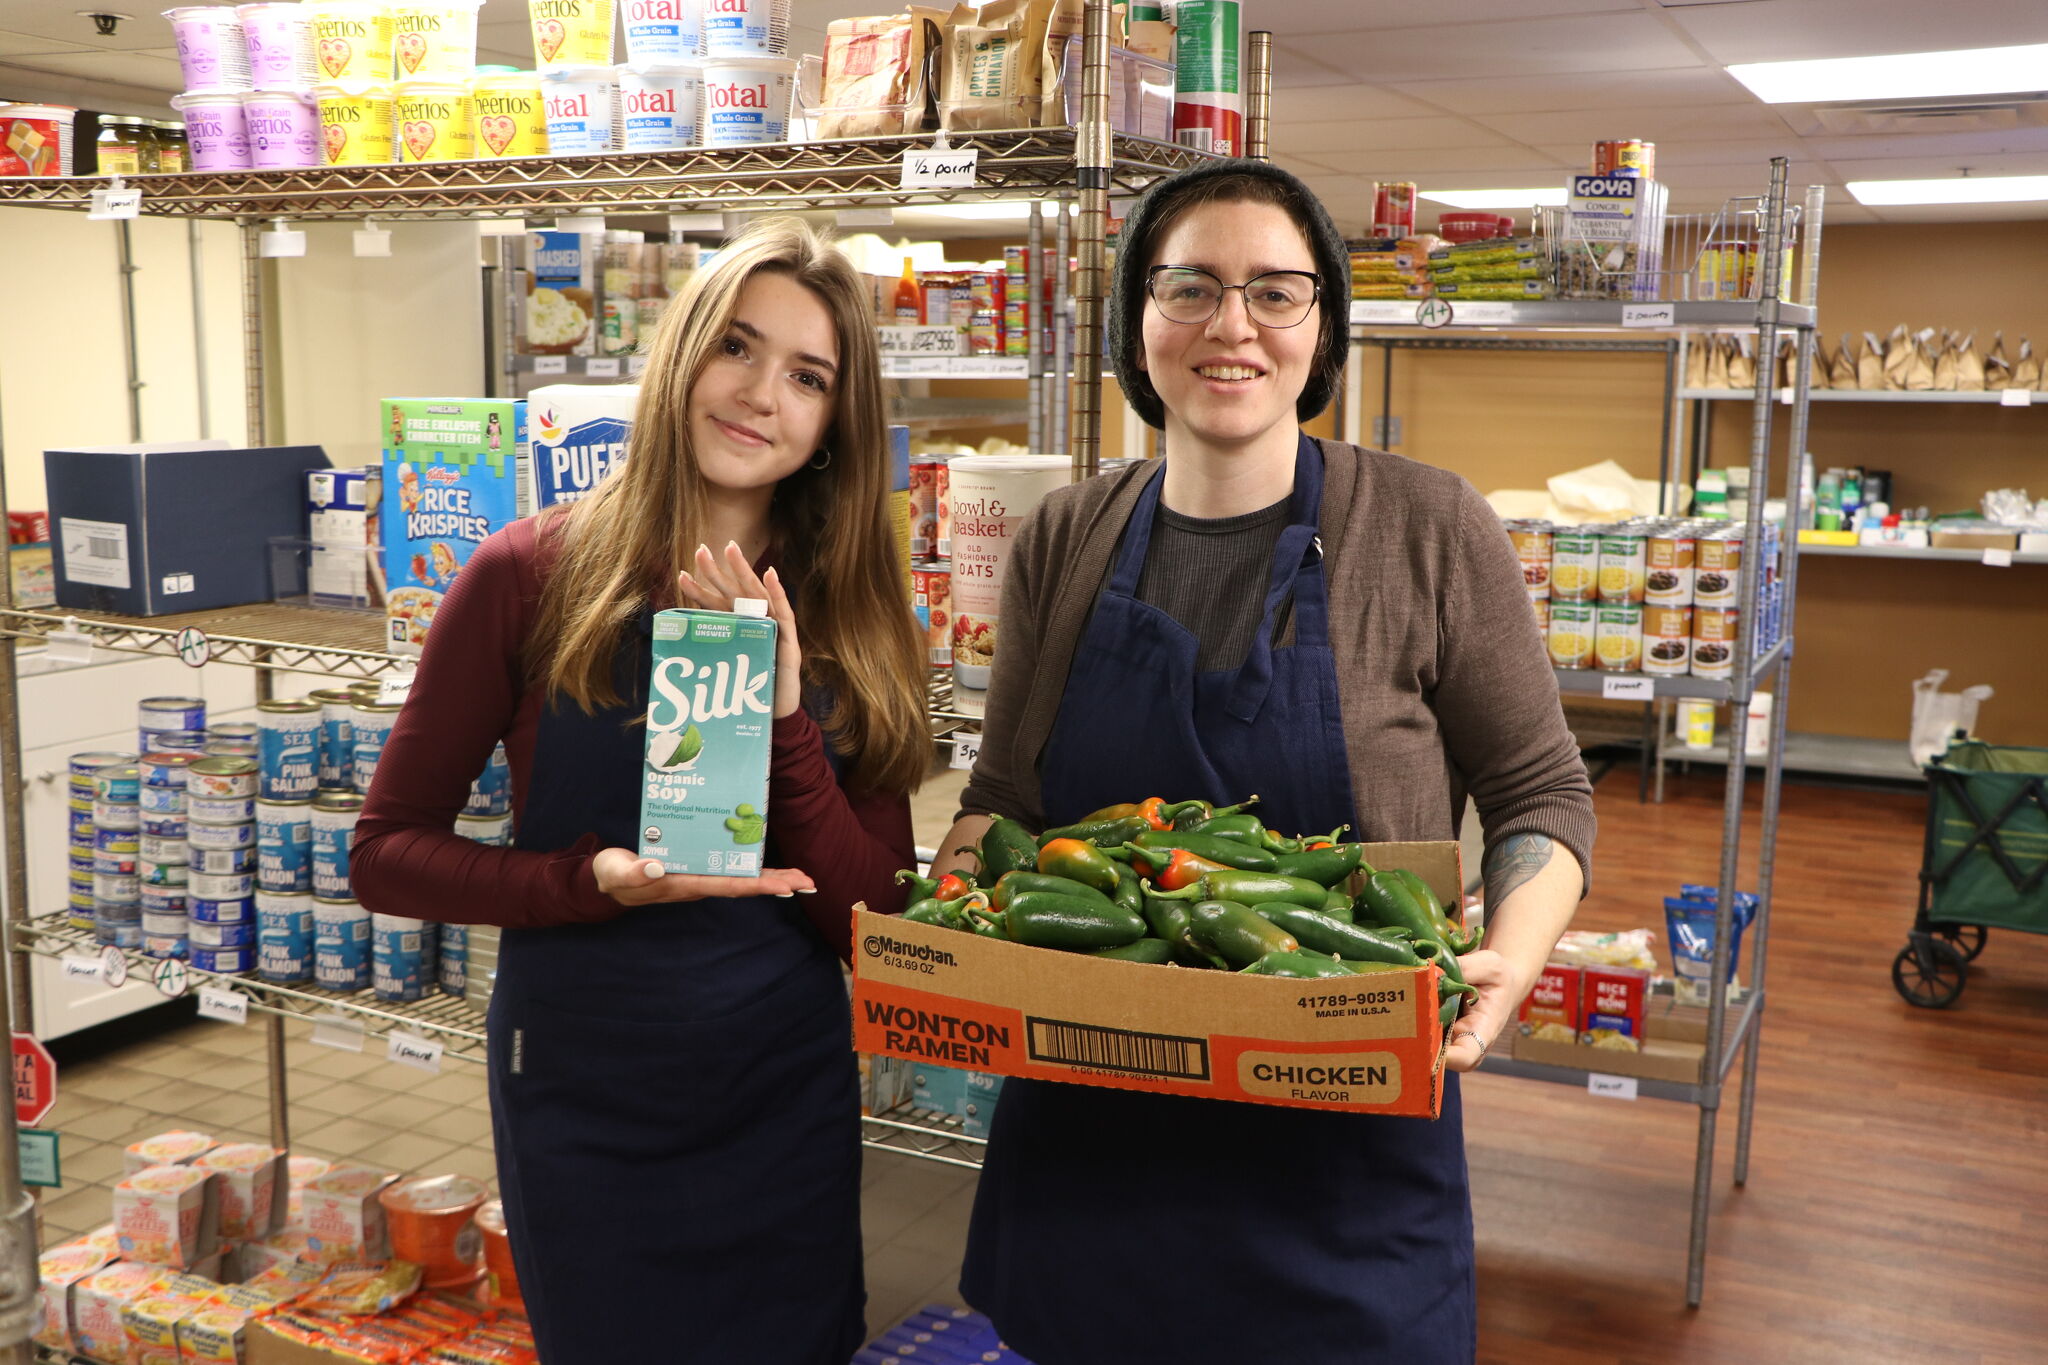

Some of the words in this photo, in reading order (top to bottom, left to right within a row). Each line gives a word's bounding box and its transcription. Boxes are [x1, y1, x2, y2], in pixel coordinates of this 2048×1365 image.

[533, 0, 581, 18] eerios
[314, 20, 367, 38] heerios
[395, 15, 441, 32] eerios
[968, 54, 989, 98] APPLES
[985, 37, 1006, 98] CINNAMON
[706, 83, 768, 109] Total
[320, 105, 361, 123] eerios
[545, 94, 590, 118] otal
[249, 119, 292, 135] eerios
[714, 114, 733, 123] Whole
[734, 114, 756, 122] Grain
[189, 122, 223, 138] eerios
[934, 160, 975, 178] point
[1576, 178, 1633, 197] GOYA
[406, 418, 430, 430] FREE
[424, 486, 471, 515] RICE
[953, 495, 986, 517] bowl
[988, 499, 1007, 517] &
[407, 512, 491, 541] KRISPIES
[953, 514, 1008, 538] basket
[957, 551, 998, 563] FASHIONED
[967, 544, 982, 553] OLD
[959, 562, 994, 578] OATS
[695, 630, 732, 638] UNSWEET
[696, 623, 731, 632] ORGANIC
[646, 653, 771, 733] Silk
[283, 733, 311, 746] SEA
[282, 763, 312, 778] PINK
[647, 771, 706, 786] Organic
[646, 783, 688, 804] Soy
[646, 810, 694, 820] Powerhouse
[647, 802, 661, 810] The
[663, 803, 694, 813] Original
[695, 806, 731, 815] Nutrition
[261, 915, 289, 929] SEA
[261, 943, 290, 960] PINK
[316, 951, 344, 968] PINK
[884, 955, 919, 971] 6/3.69
[919, 962, 935, 975] OZ
[1597, 981, 1628, 996] RICE
[1296, 989, 1406, 1009] 41789-90331
[1315, 1009, 1346, 1018] MADE
[1347, 1008, 1359, 1017] IN
[1360, 1006, 1391, 1016] U.S.A.
[864, 999, 1010, 1049] WONTON
[886, 1030, 991, 1066] RAMEN
[24, 1055, 34, 1069] A
[967, 1071, 994, 1091] Soy
[1252, 1063, 1387, 1086] CHICKEN
[1291, 1088, 1350, 1102] FLAVOR
